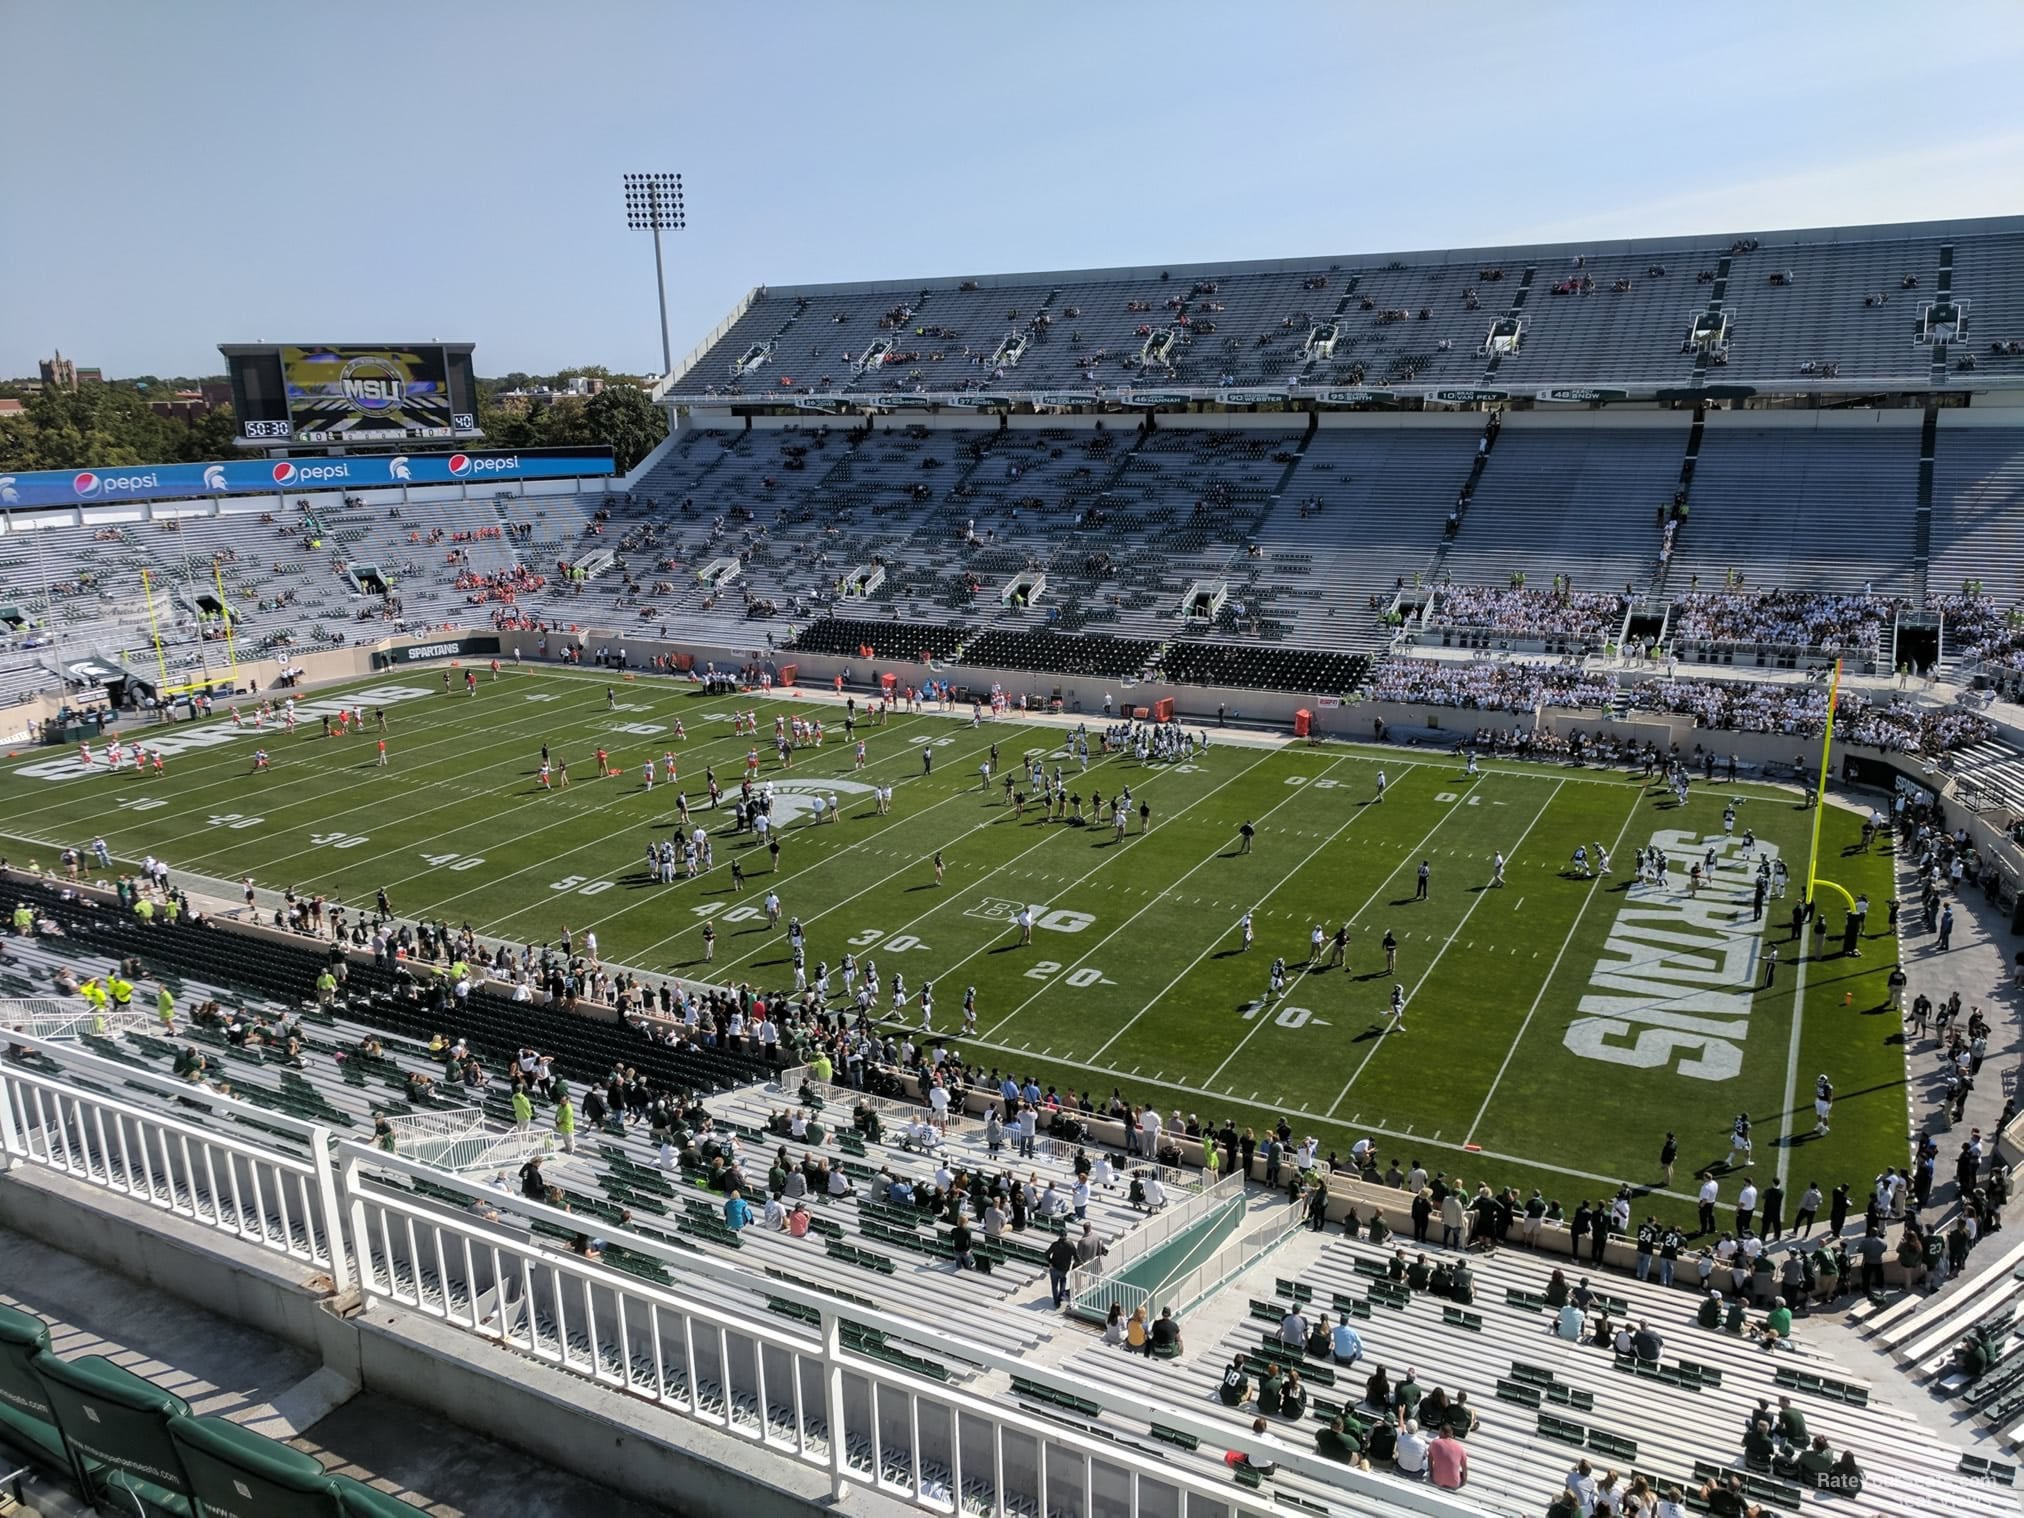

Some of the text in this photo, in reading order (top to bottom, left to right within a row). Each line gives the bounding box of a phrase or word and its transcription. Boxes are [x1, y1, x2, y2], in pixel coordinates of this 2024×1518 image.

[343, 379, 401, 401] MSU
[456, 415, 472, 428] 40
[300, 463, 348, 481] pepsi
[474, 456, 518, 473] pepsi
[103, 473, 158, 493] pepsi
[408, 643, 460, 659] SPARTANS
[1283, 776, 1340, 789] 20
[1434, 792, 1480, 806] 10
[206, 814, 264, 829] 20
[311, 832, 370, 848] 30
[425, 853, 485, 871] 40
[549, 875, 616, 895] 50
[690, 901, 760, 923] 40
[847, 929, 921, 953] 30
[1562, 829, 1780, 1081] SPARTANS
[1023, 961, 1103, 987] 20
[1242, 1000, 1312, 1029] 10
[1640, 1230, 1652, 1243] 24
[1665, 1235, 1678, 1248] 24
[1225, 1369, 1241, 1387] 18
